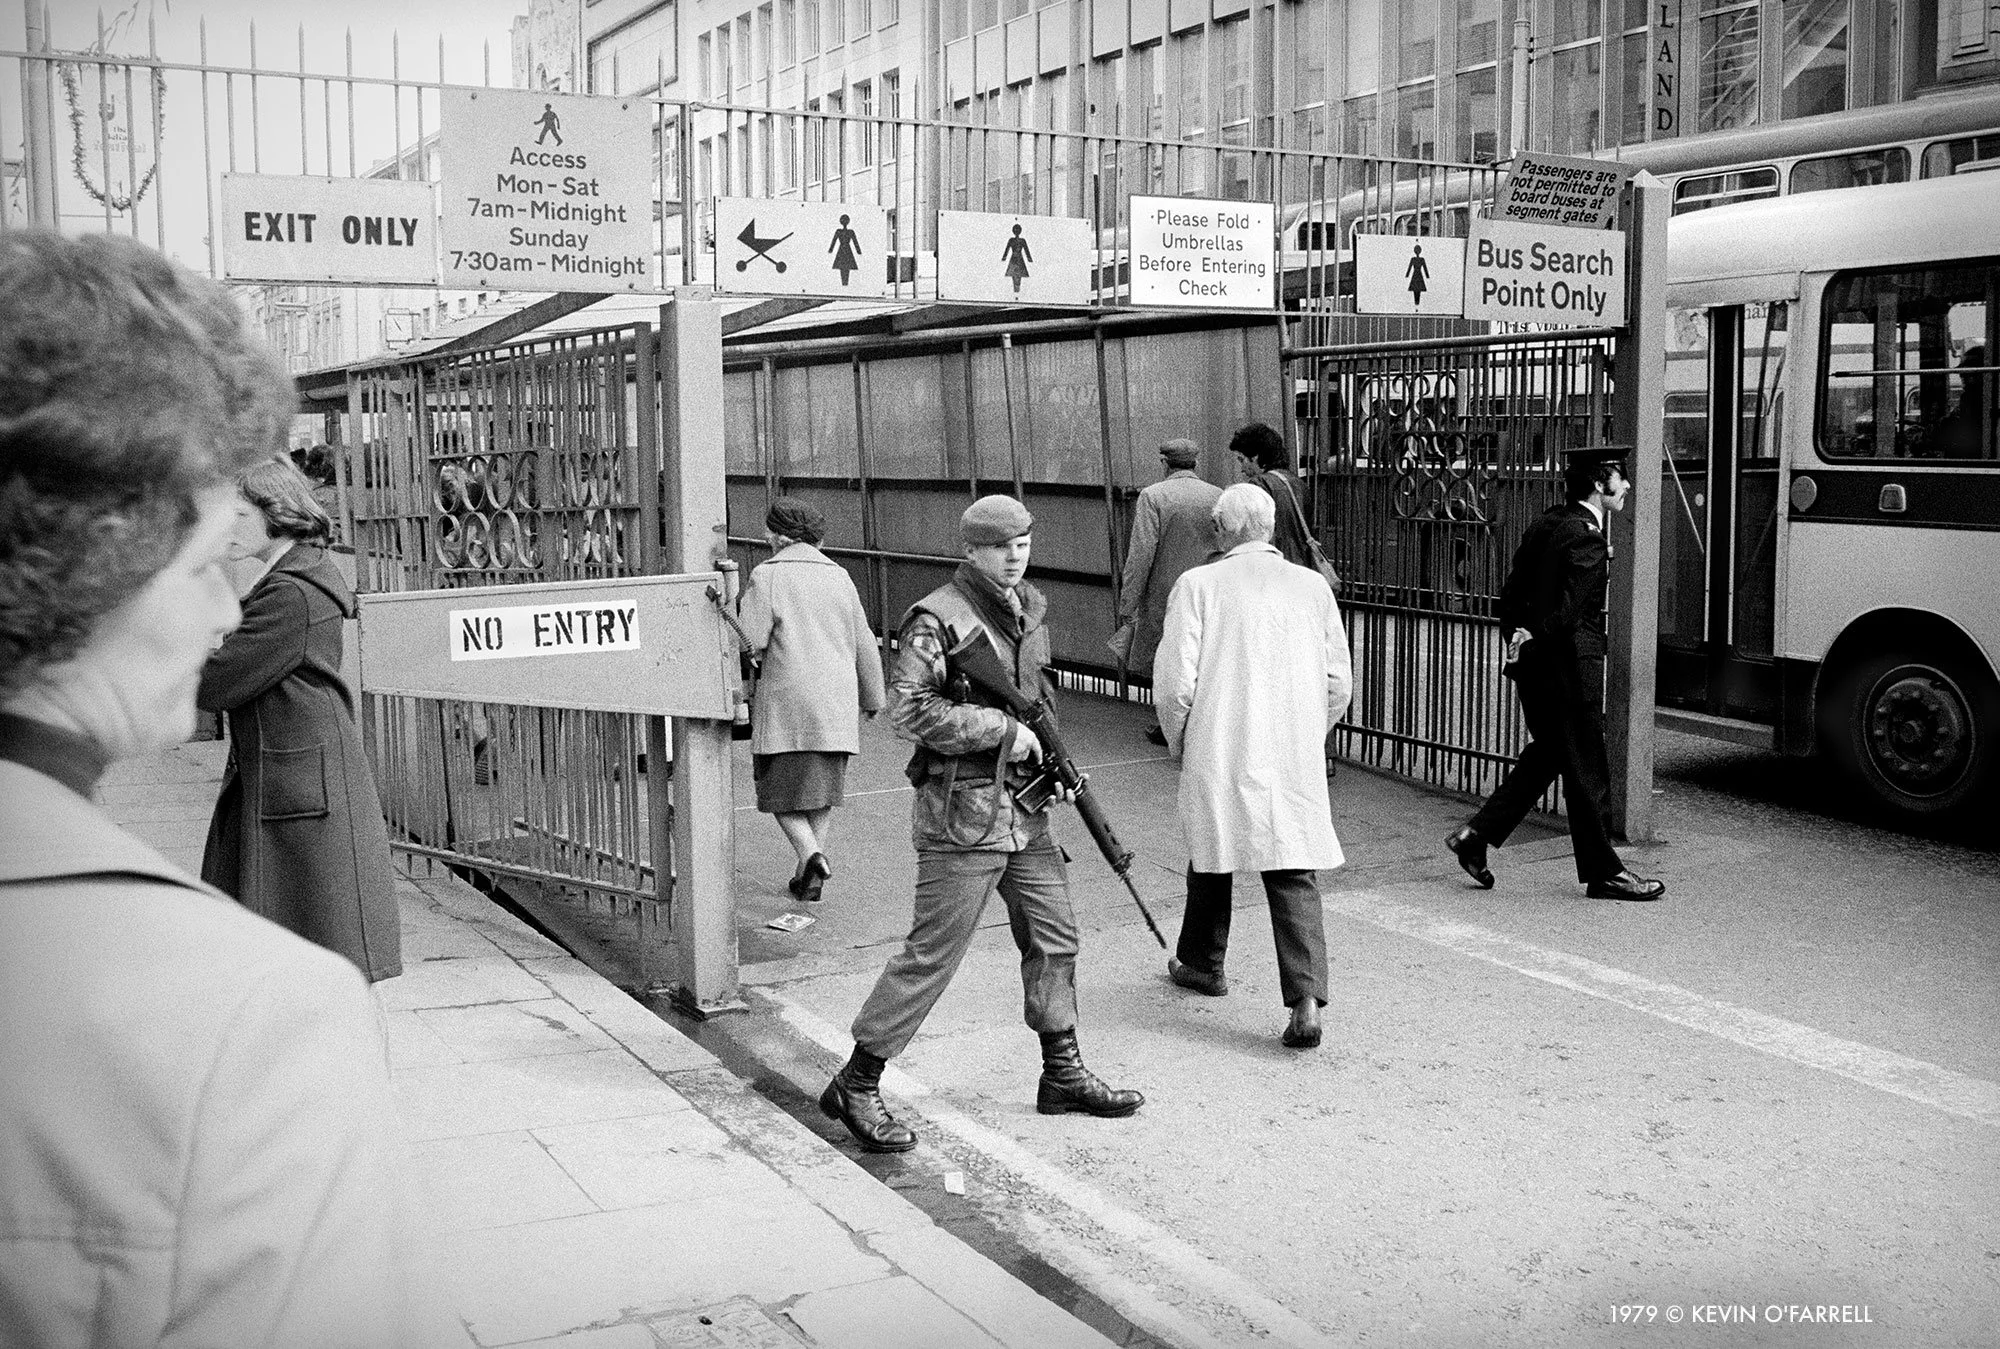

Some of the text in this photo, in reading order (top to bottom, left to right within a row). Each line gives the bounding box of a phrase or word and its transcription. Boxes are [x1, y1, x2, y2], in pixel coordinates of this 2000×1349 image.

[509, 145, 588, 170] Access
[1520, 159, 1618, 184] Passengers are
[1509, 175, 1616, 198] not permitted to
[1510, 187, 1605, 211] board buses at
[1156, 208, 1250, 230] Please Fold
[1505, 204, 1599, 225] segment gates
[244, 211, 419, 247] EXIT ONLY
[508, 226, 589, 252] Sunday
[1161, 231, 1244, 252] Umbrellas
[1139, 253, 1267, 279] Before Entering
[1477, 239, 1614, 277] Bus Search
[1178, 278, 1228, 297] Check
[1482, 276, 1607, 318] Point Only
[462, 607, 635, 653] NO ENTRY
